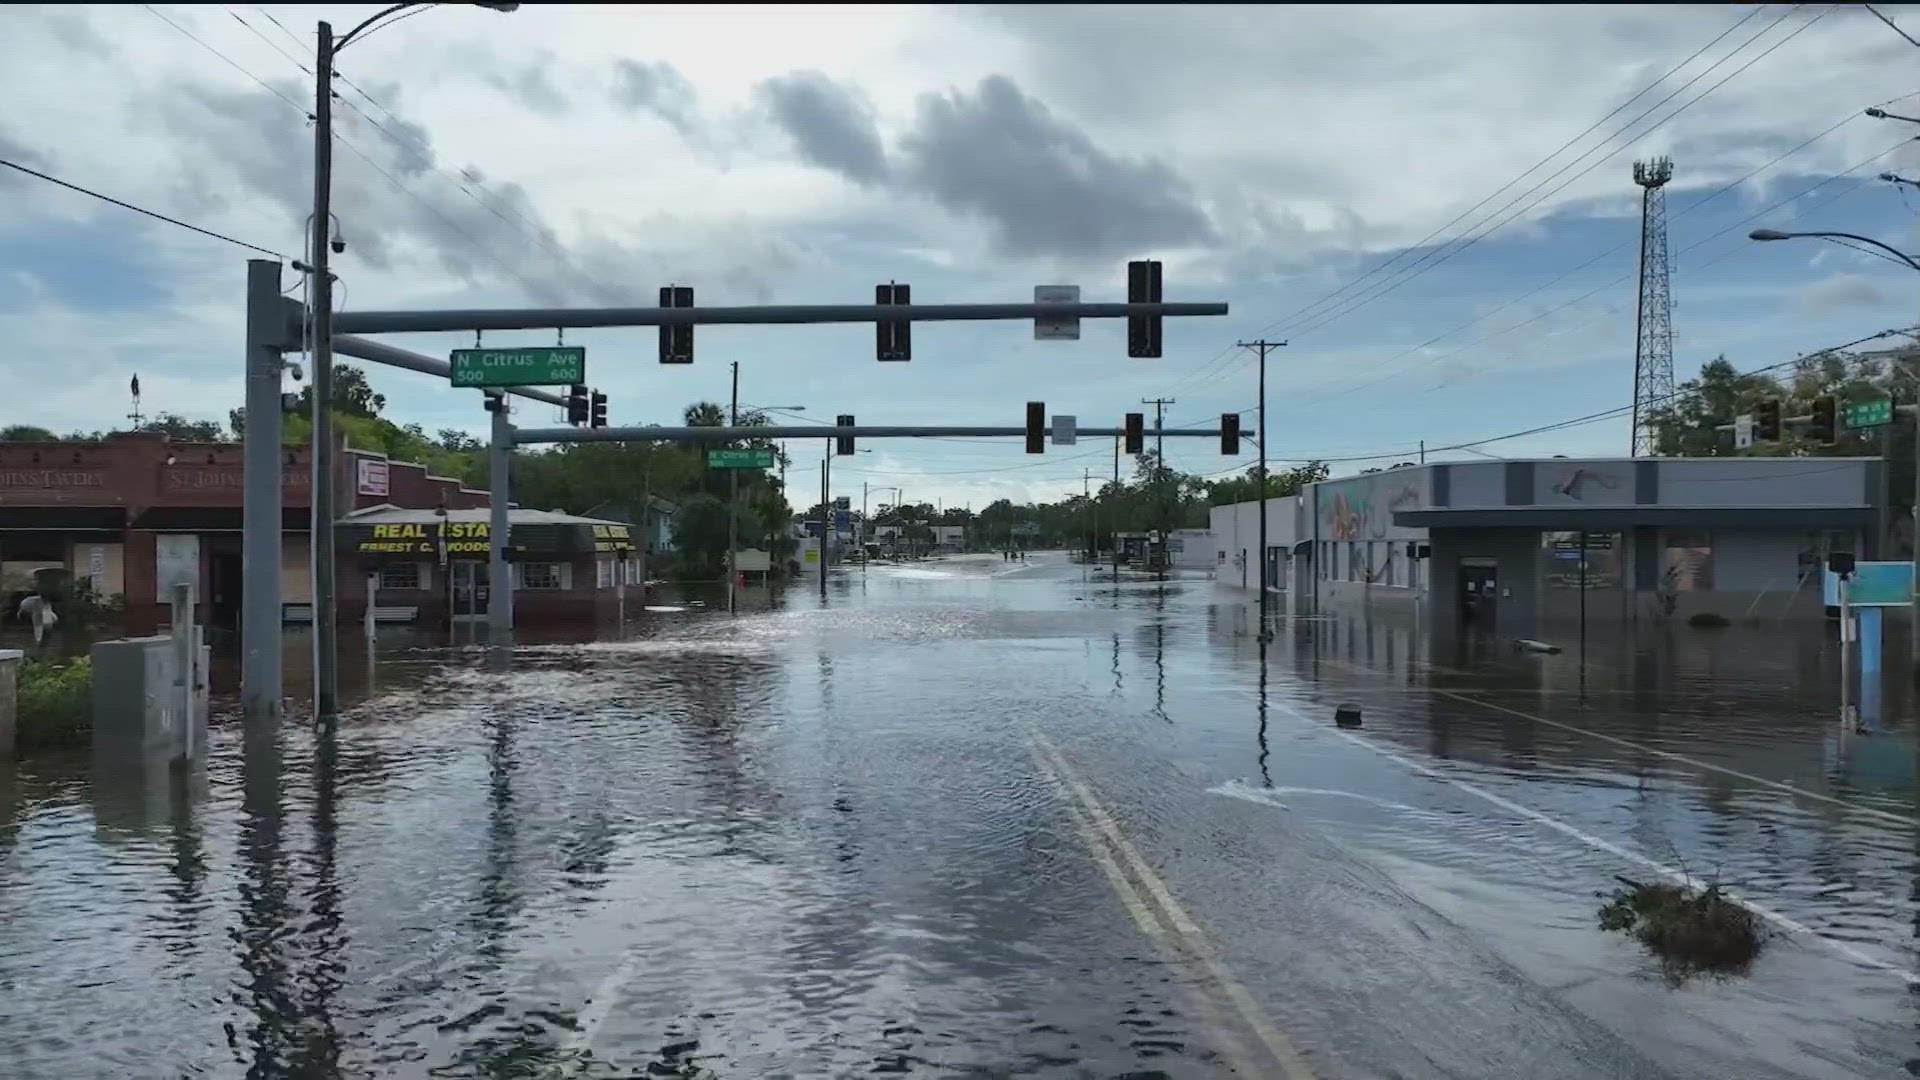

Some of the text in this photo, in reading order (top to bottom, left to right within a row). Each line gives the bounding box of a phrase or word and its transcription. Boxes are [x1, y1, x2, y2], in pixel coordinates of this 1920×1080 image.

[457, 351, 578, 367] N Citrus Ave
[458, 368, 577, 381] 500 600
[373, 523, 512, 539] REAL ESTA
